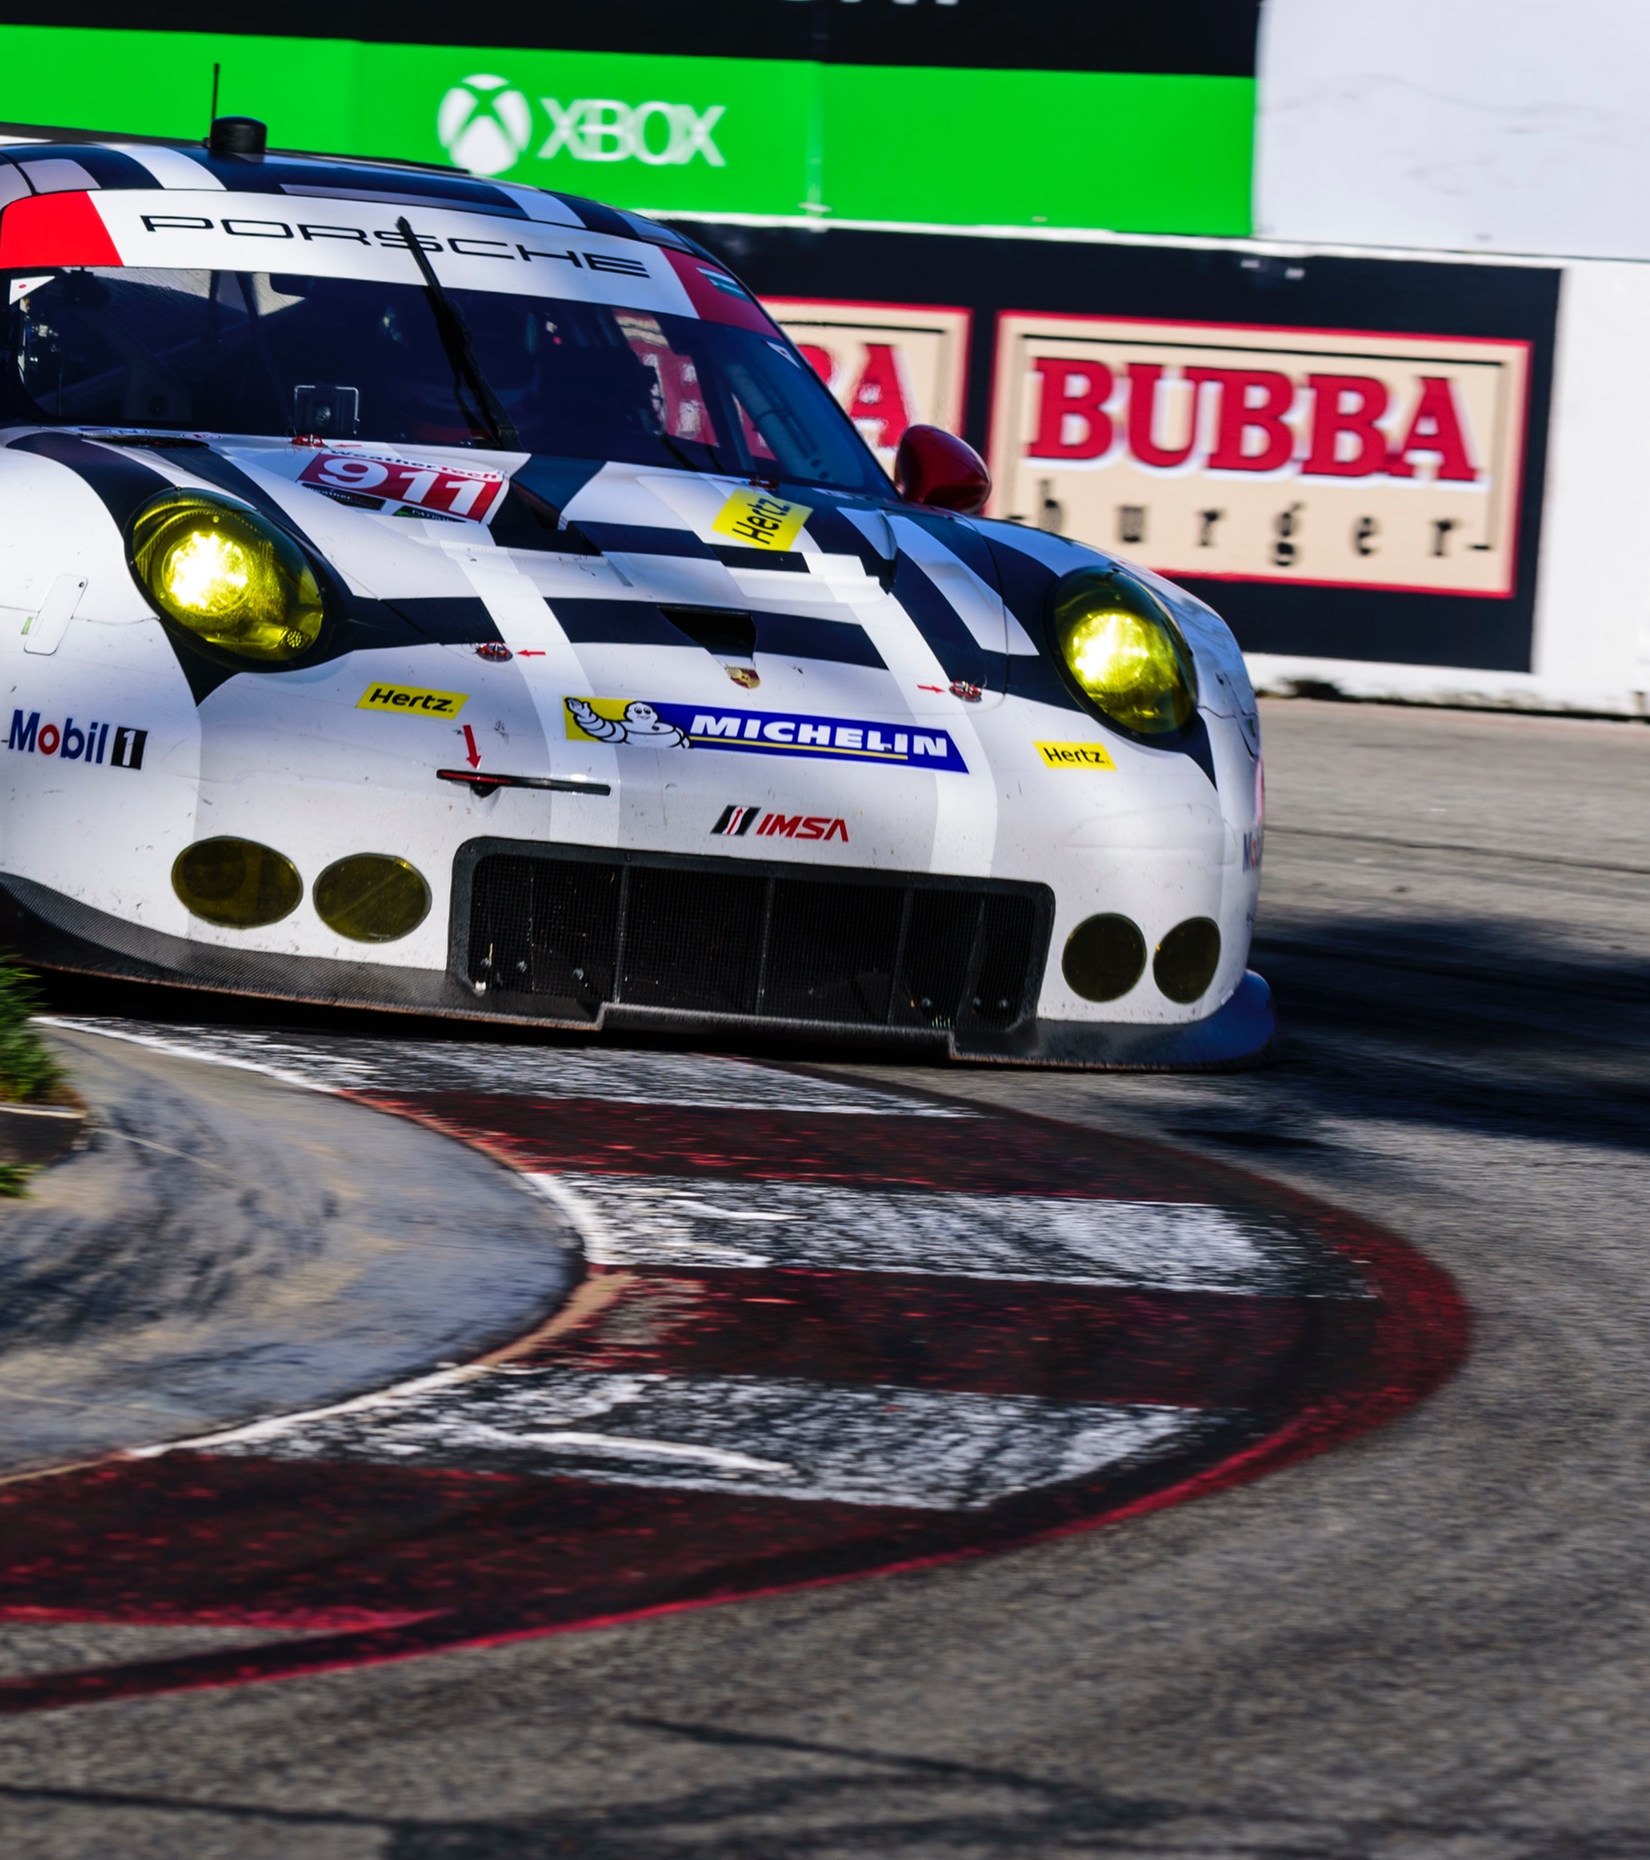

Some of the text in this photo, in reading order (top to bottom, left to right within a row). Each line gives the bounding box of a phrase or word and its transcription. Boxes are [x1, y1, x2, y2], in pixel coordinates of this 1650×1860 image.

[537, 97, 728, 167] XBOX
[139, 214, 651, 279] PORSCHE
[1027, 356, 1482, 482] BUBBA
[317, 457, 487, 516] 911
[331, 450, 497, 480] WeatherTech
[731, 497, 792, 546] Hertz
[358, 687, 454, 713] Hertz
[8, 708, 110, 765] Mobil
[689, 713, 949, 758] MICHELIN
[1042, 747, 1107, 764] Hertz
[755, 812, 850, 843] IMSA
